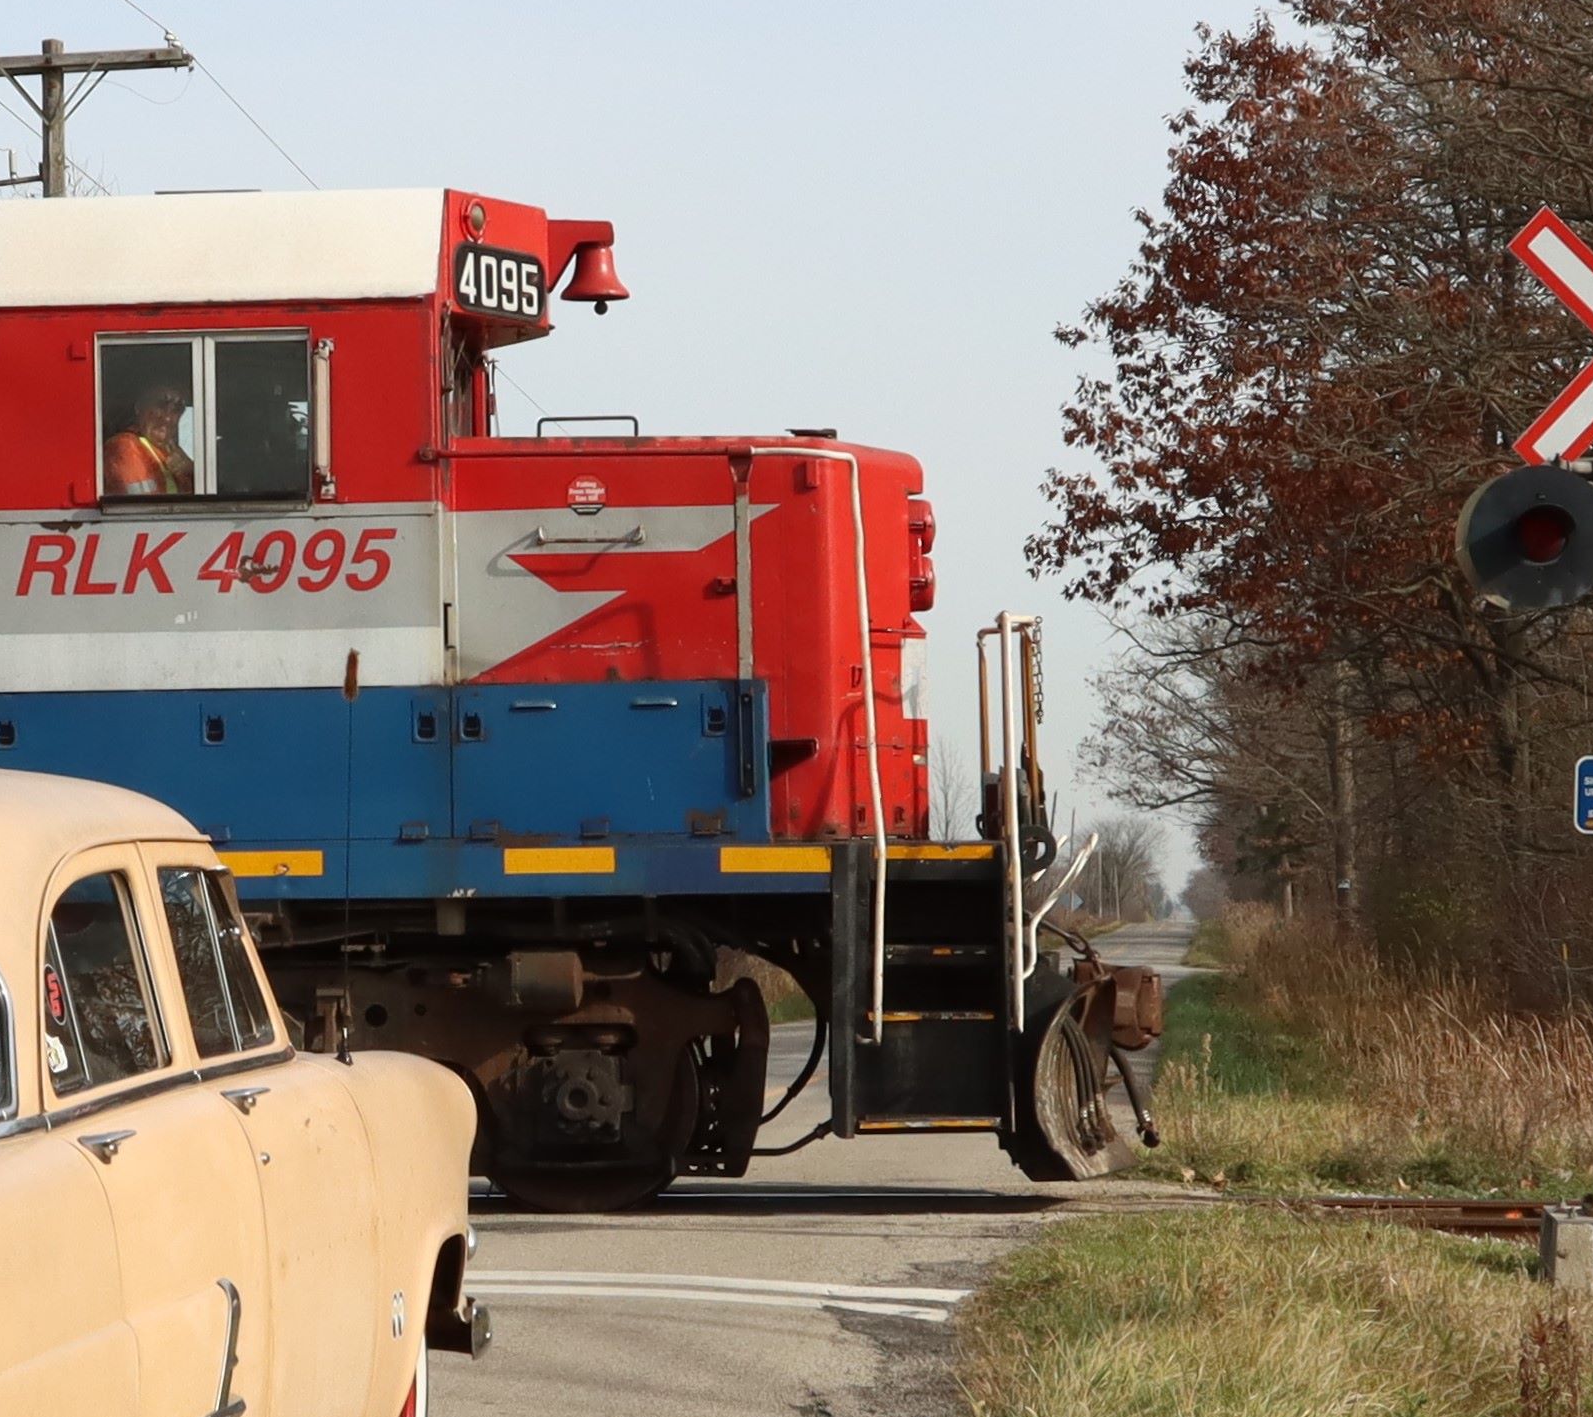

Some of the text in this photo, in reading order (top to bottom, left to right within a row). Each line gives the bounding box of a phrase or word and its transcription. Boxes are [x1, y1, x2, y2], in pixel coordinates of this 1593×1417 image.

[459, 251, 539, 316] 4095
[15, 527, 398, 597] RLK 4095
